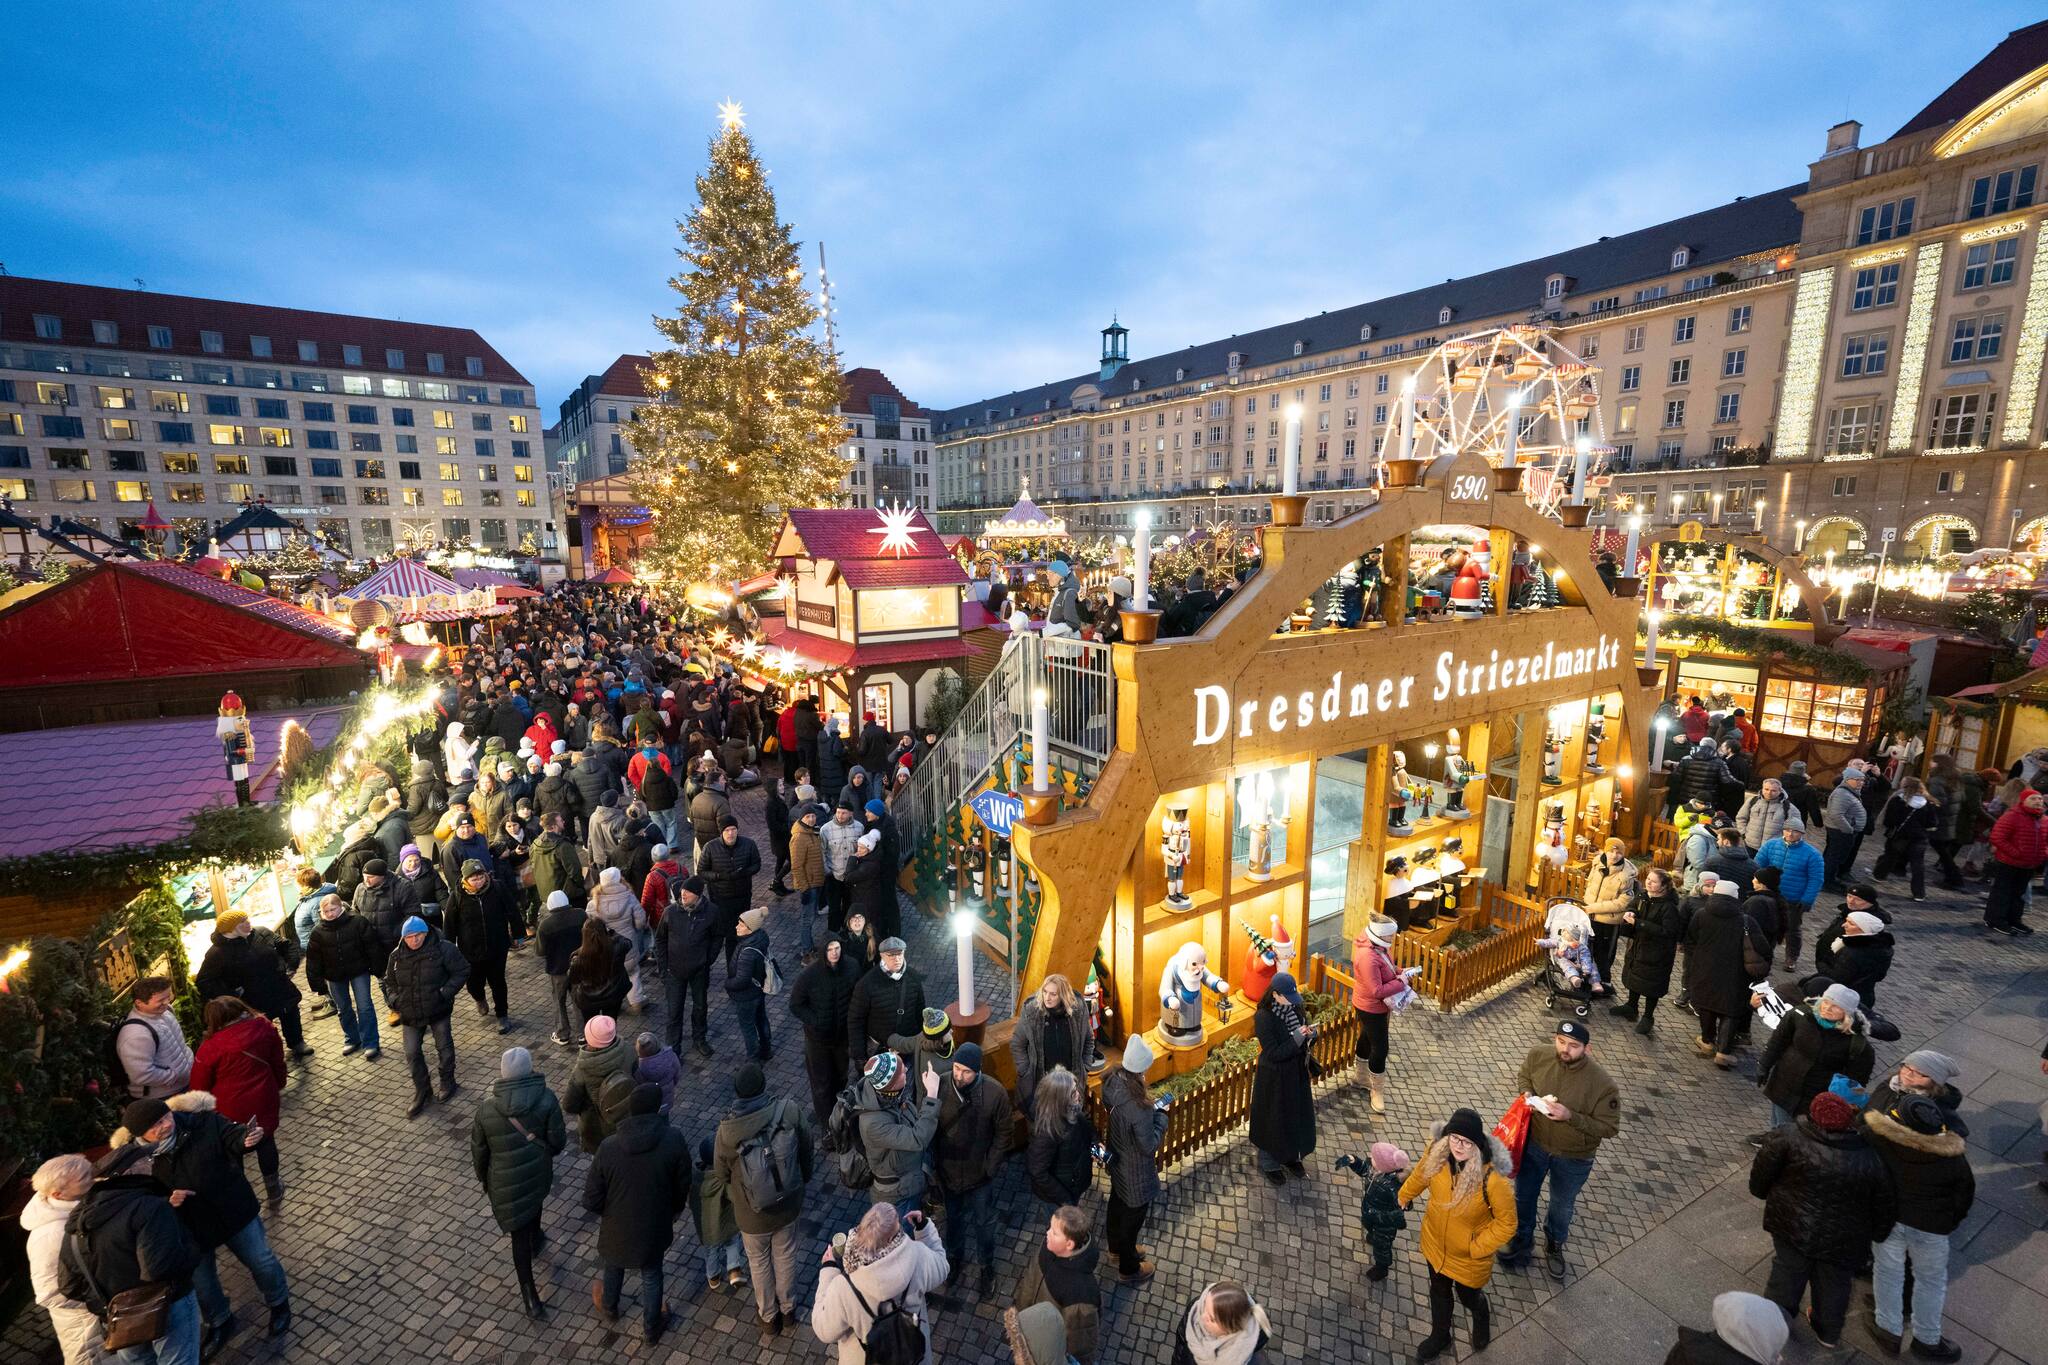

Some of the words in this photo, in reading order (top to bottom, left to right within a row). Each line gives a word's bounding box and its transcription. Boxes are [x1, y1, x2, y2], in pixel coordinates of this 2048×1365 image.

[1450, 475, 1489, 501] 590.
[1193, 671, 1415, 746] Dresdner
[1434, 633, 1620, 702] Striezelmarkt
[989, 797, 1016, 831] WC
